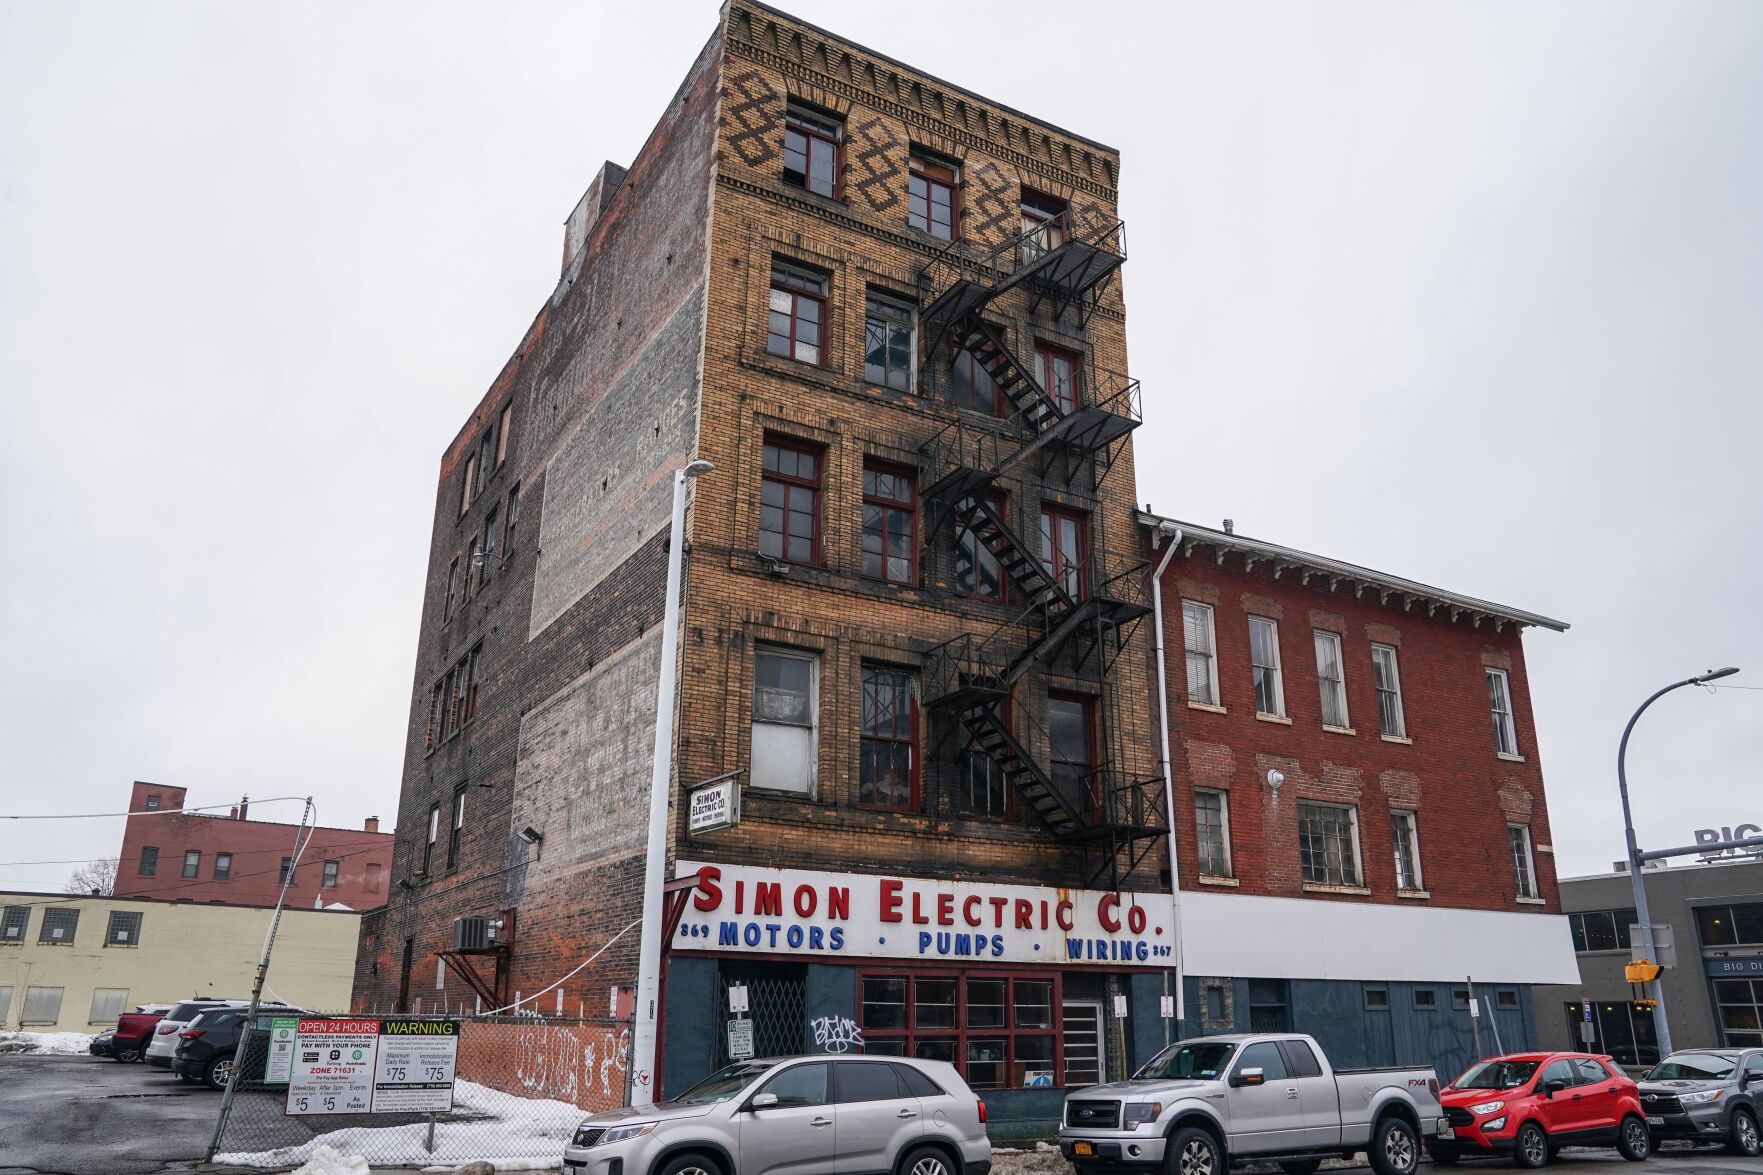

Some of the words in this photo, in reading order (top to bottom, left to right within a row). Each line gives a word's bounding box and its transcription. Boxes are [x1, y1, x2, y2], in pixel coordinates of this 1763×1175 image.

[696, 790, 722, 805] SIMON
[692, 802, 717, 816] ELECTRIC
[694, 866, 850, 921] SIMON
[880, 879, 1074, 931] ELECTRIC
[681, 923, 710, 937] 369
[718, 922, 845, 950] MOTORS
[919, 931, 1004, 957] PUMPS
[1066, 938, 1149, 961] WIRING
[1153, 945, 1172, 957] 367
[1724, 963, 1744, 971] BIG
[299, 1022, 327, 1032] OPEN
[329, 1022, 340, 1032] 24
[342, 1022, 377, 1032] HOURS
[386, 1022, 453, 1034] WARNING
[386, 1068, 406, 1080] $75
[425, 1067, 444, 1080] $75
[296, 1097, 308, 1111] $5
[323, 1097, 336, 1111] $5
